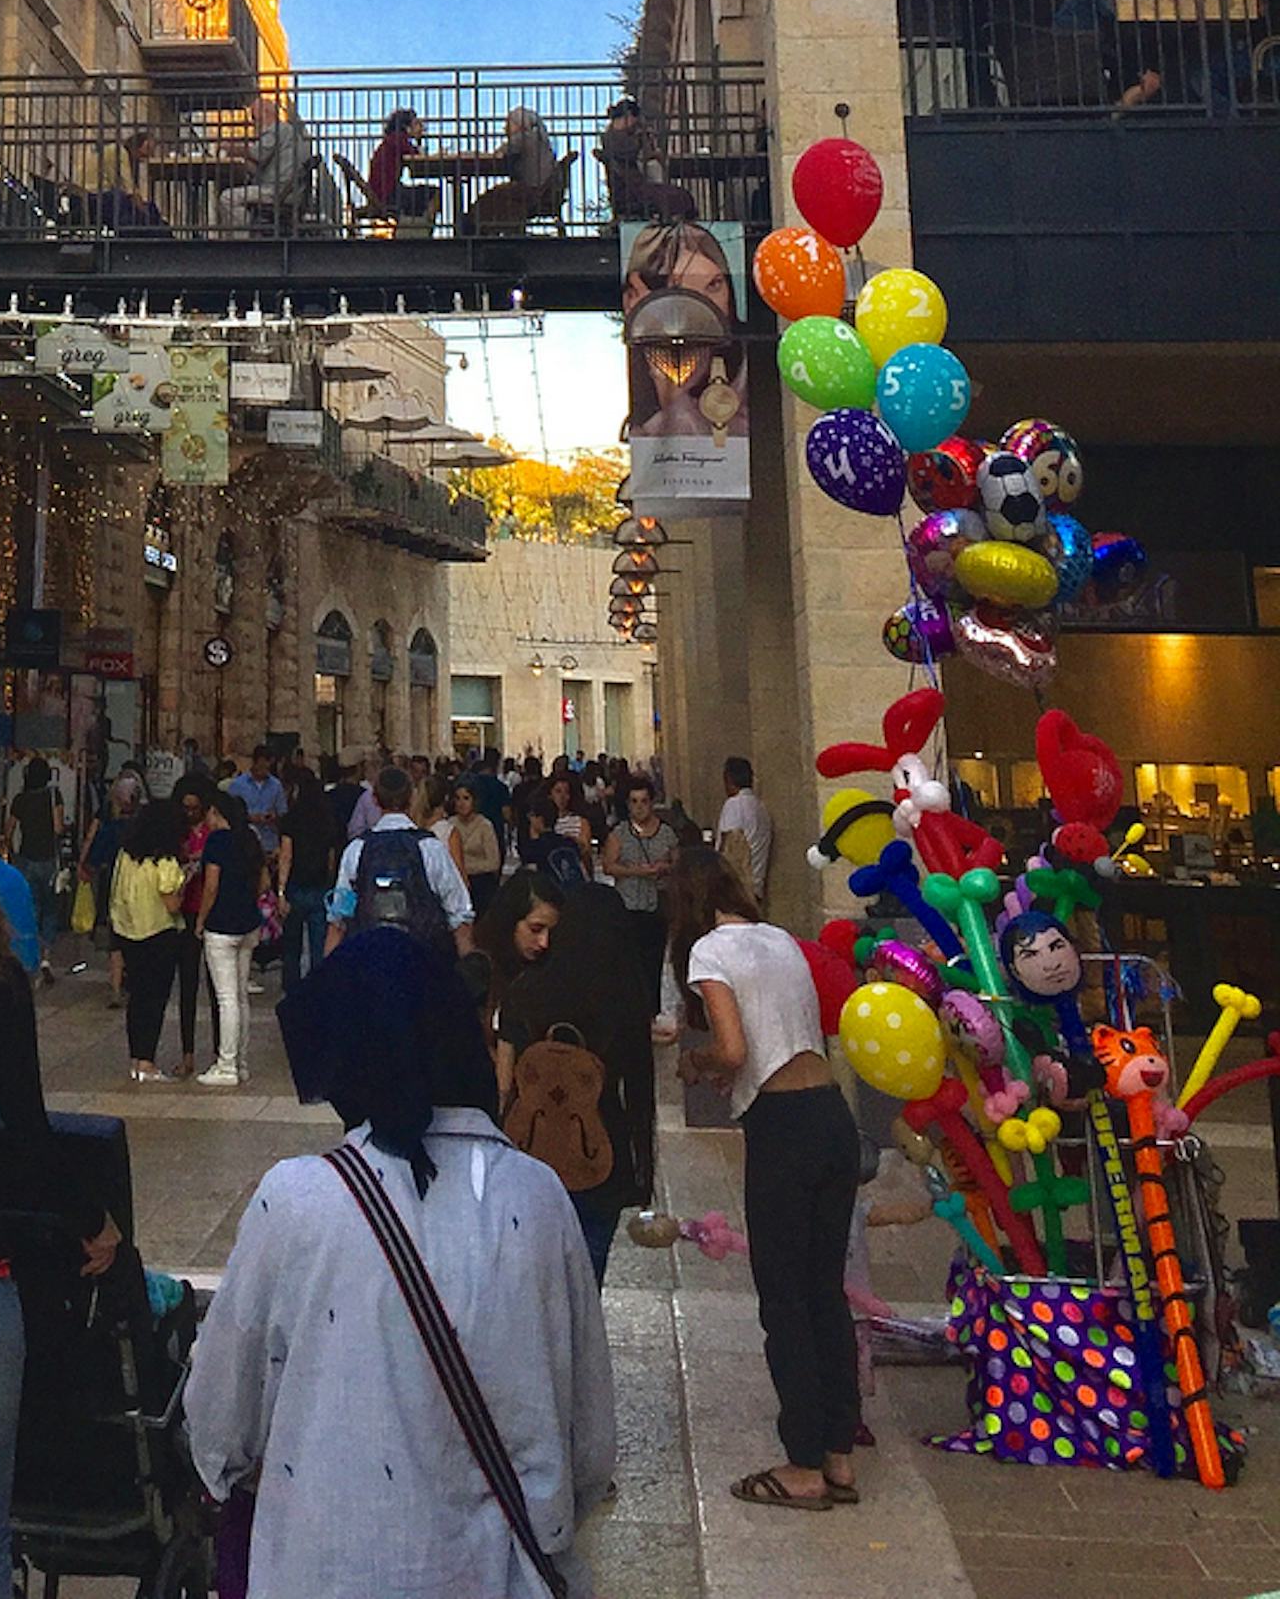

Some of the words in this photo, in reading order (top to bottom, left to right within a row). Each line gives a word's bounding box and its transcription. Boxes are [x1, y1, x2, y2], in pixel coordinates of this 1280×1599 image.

[905, 287, 933, 318] 2
[833, 322, 862, 350] 9
[61, 348, 108, 370] greg
[790, 361, 815, 389] 9
[883, 365, 904, 397] 5
[949, 379, 967, 411] 5
[823, 446, 858, 486] 4
[1032, 449, 1082, 503] 60
[89, 657, 129, 673] FOX
